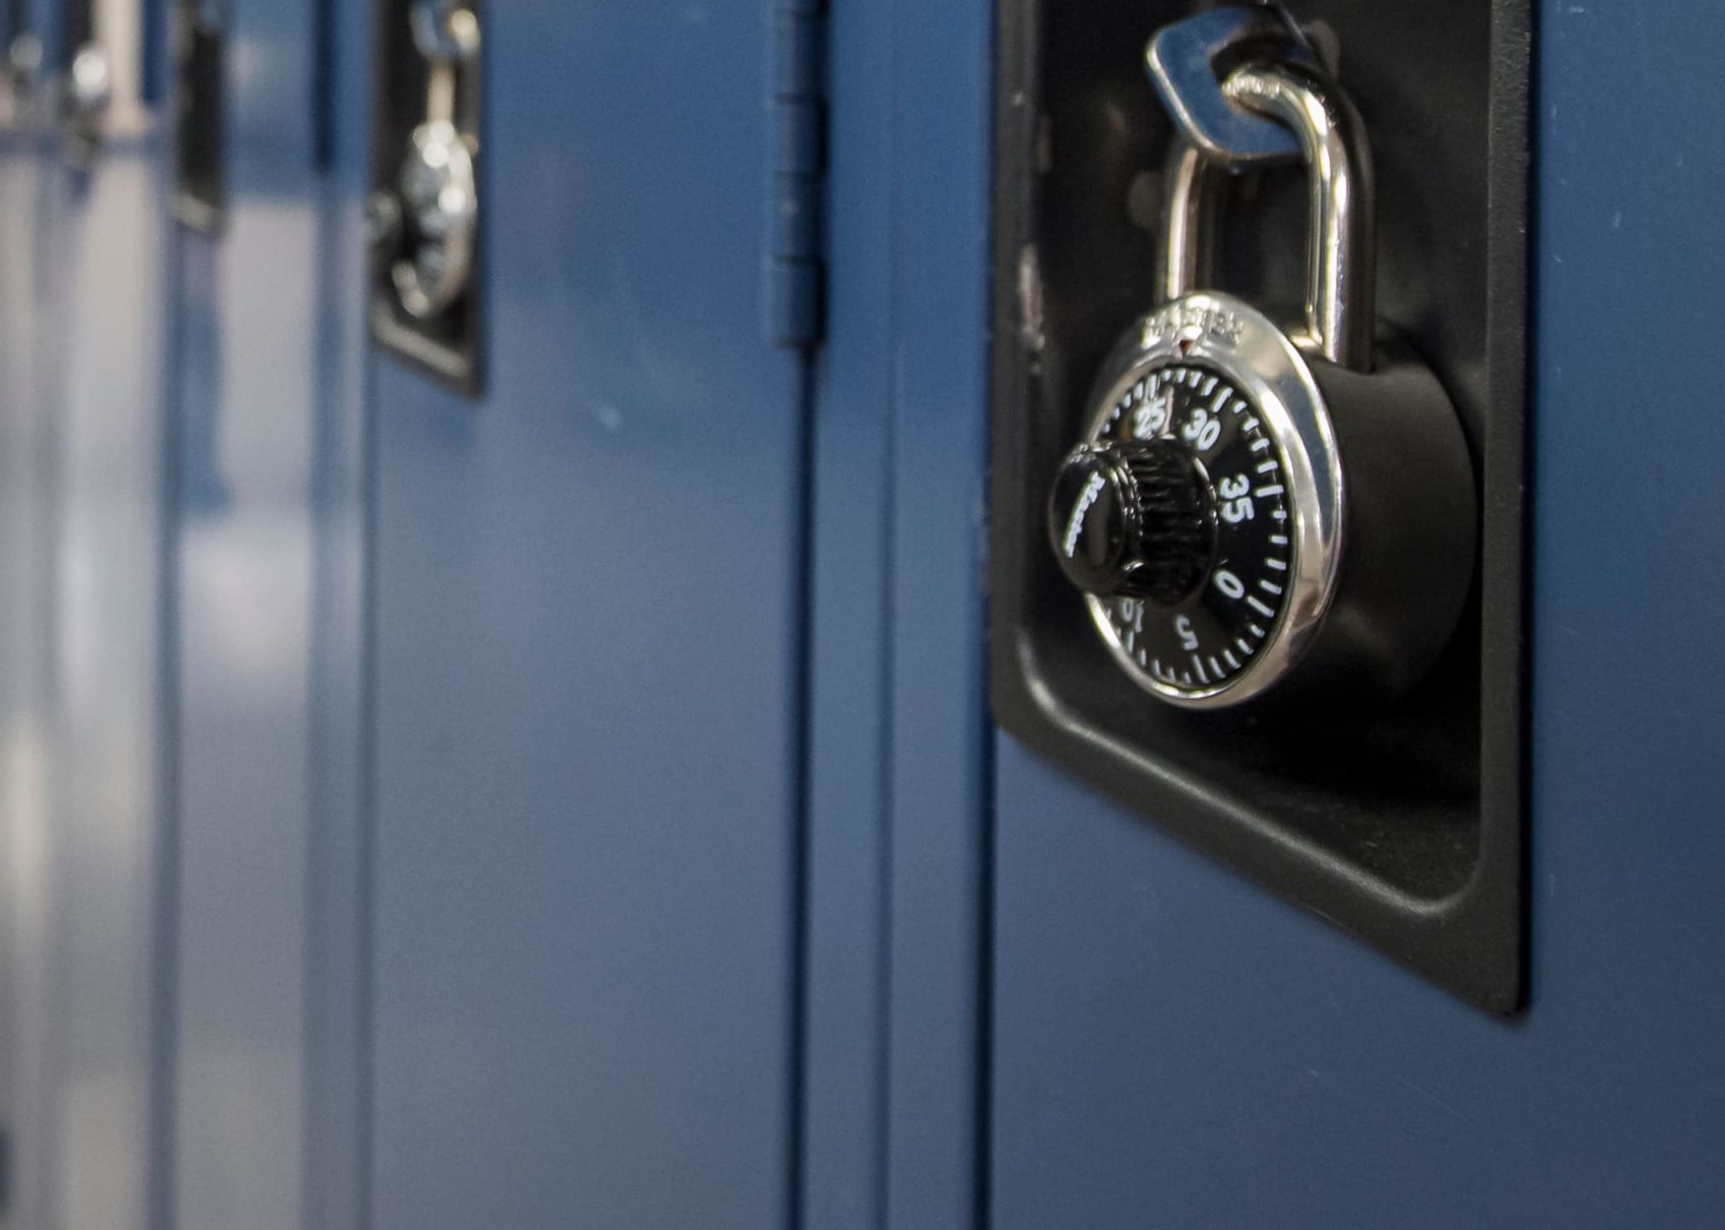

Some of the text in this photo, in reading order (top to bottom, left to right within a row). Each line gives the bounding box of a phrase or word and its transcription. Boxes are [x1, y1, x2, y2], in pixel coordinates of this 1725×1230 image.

[1134, 397, 1166, 438] 25
[1183, 408, 1221, 451] 30
[1220, 474, 1254, 523] 35
[1215, 570, 1245, 599] 0
[1177, 615, 1199, 651] 5
